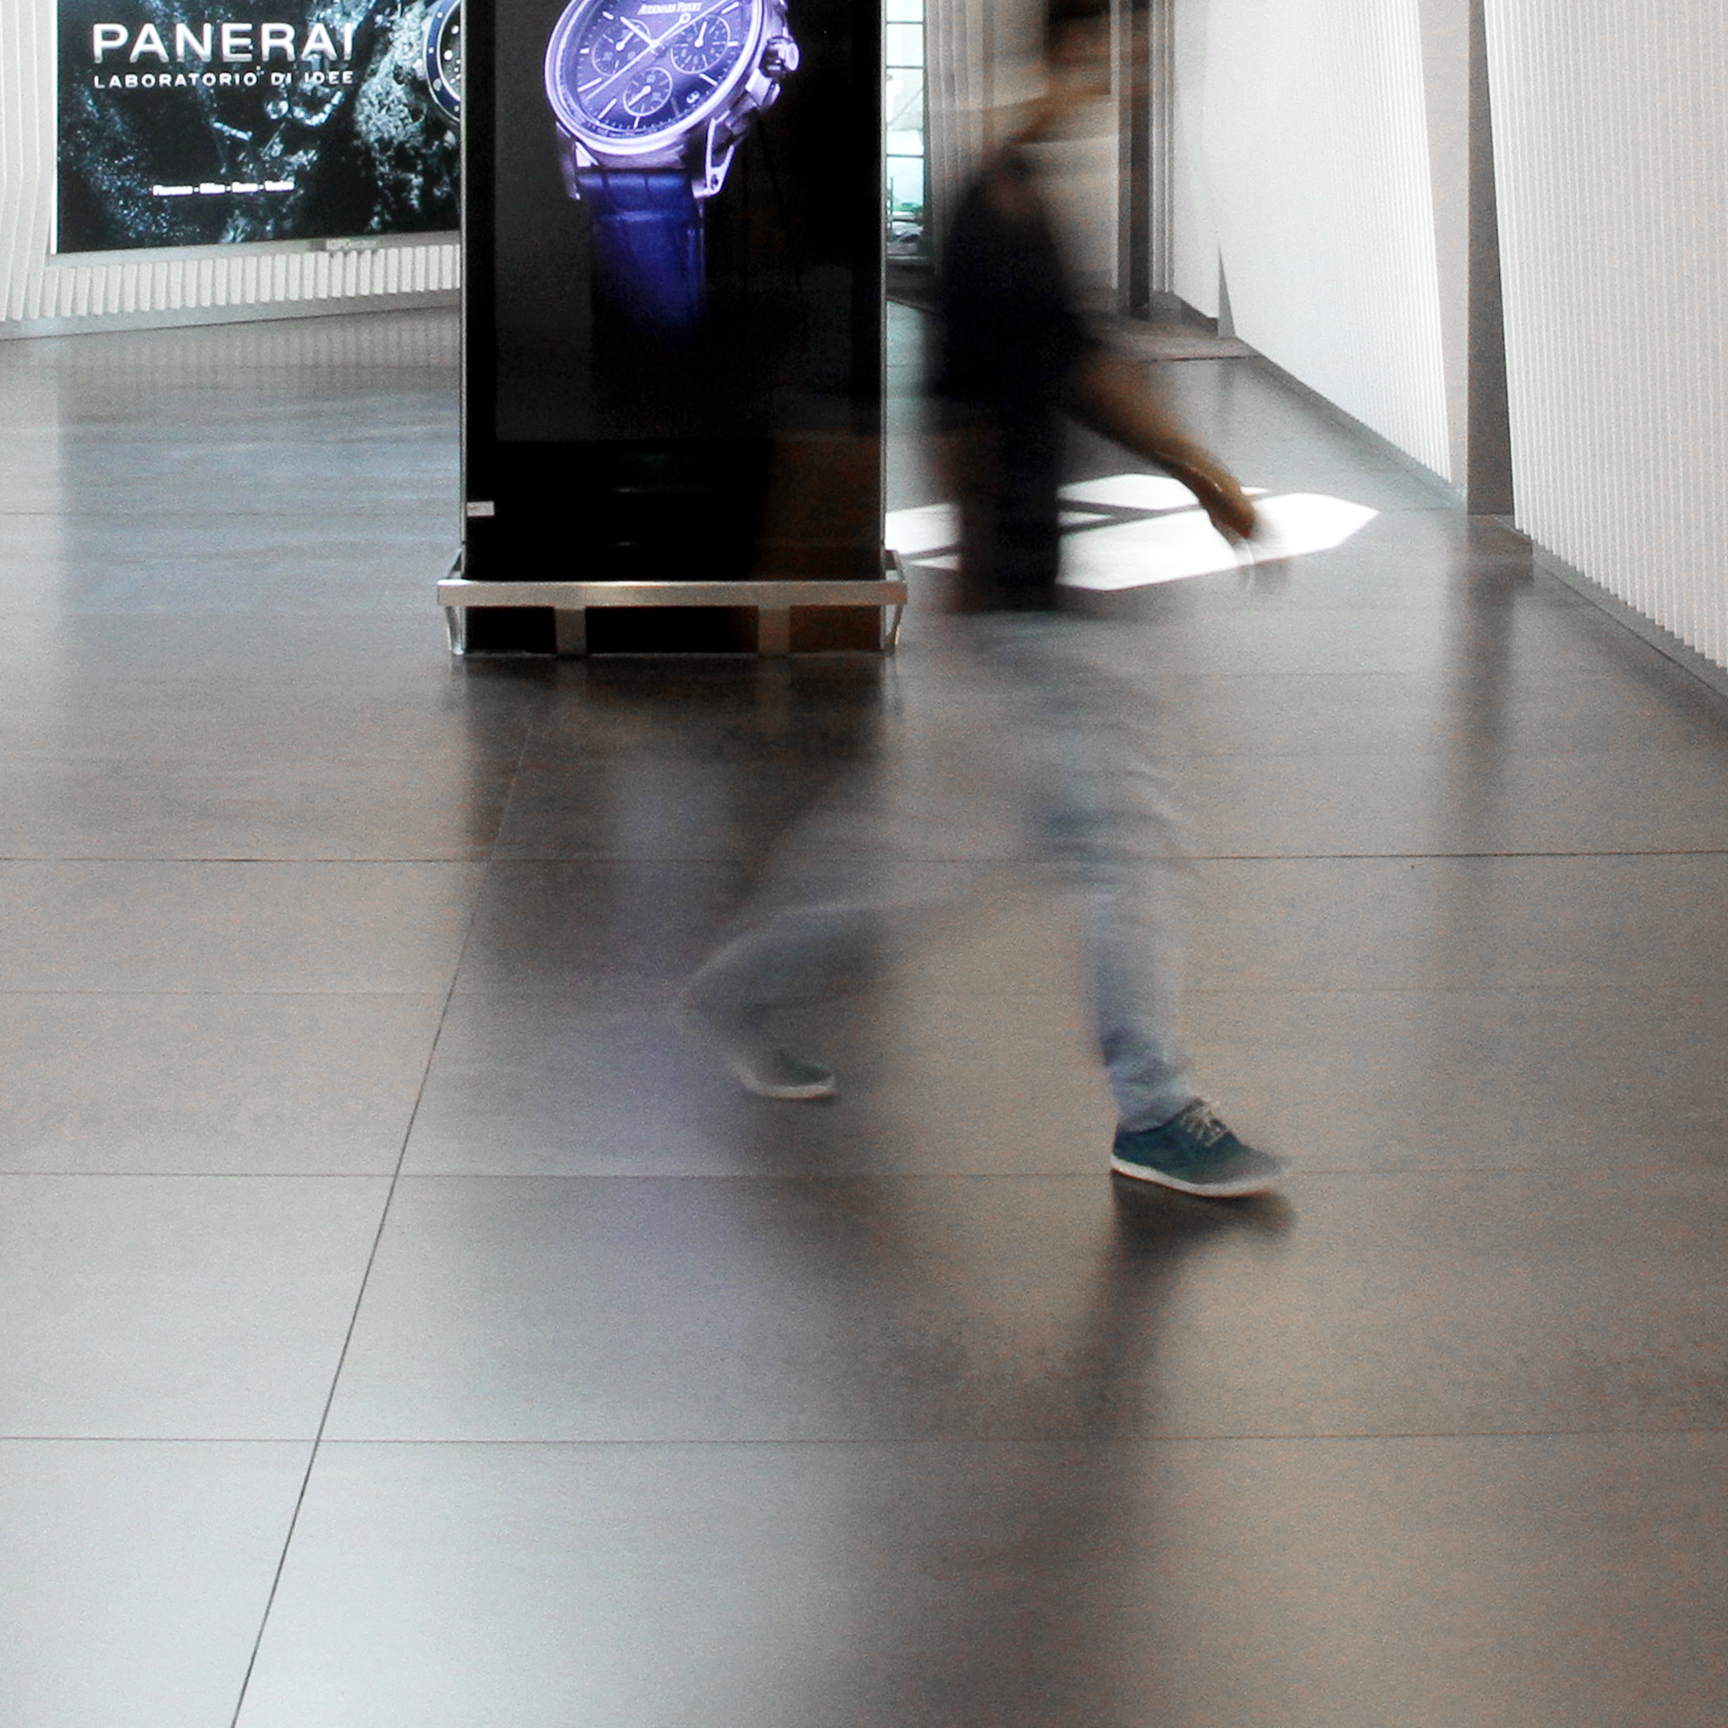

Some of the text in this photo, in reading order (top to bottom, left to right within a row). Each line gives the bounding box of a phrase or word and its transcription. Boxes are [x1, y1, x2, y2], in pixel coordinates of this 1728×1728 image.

[92, 22, 353, 64] PANERAI
[94, 71, 354, 89] LABORATORIO DI IDEE
